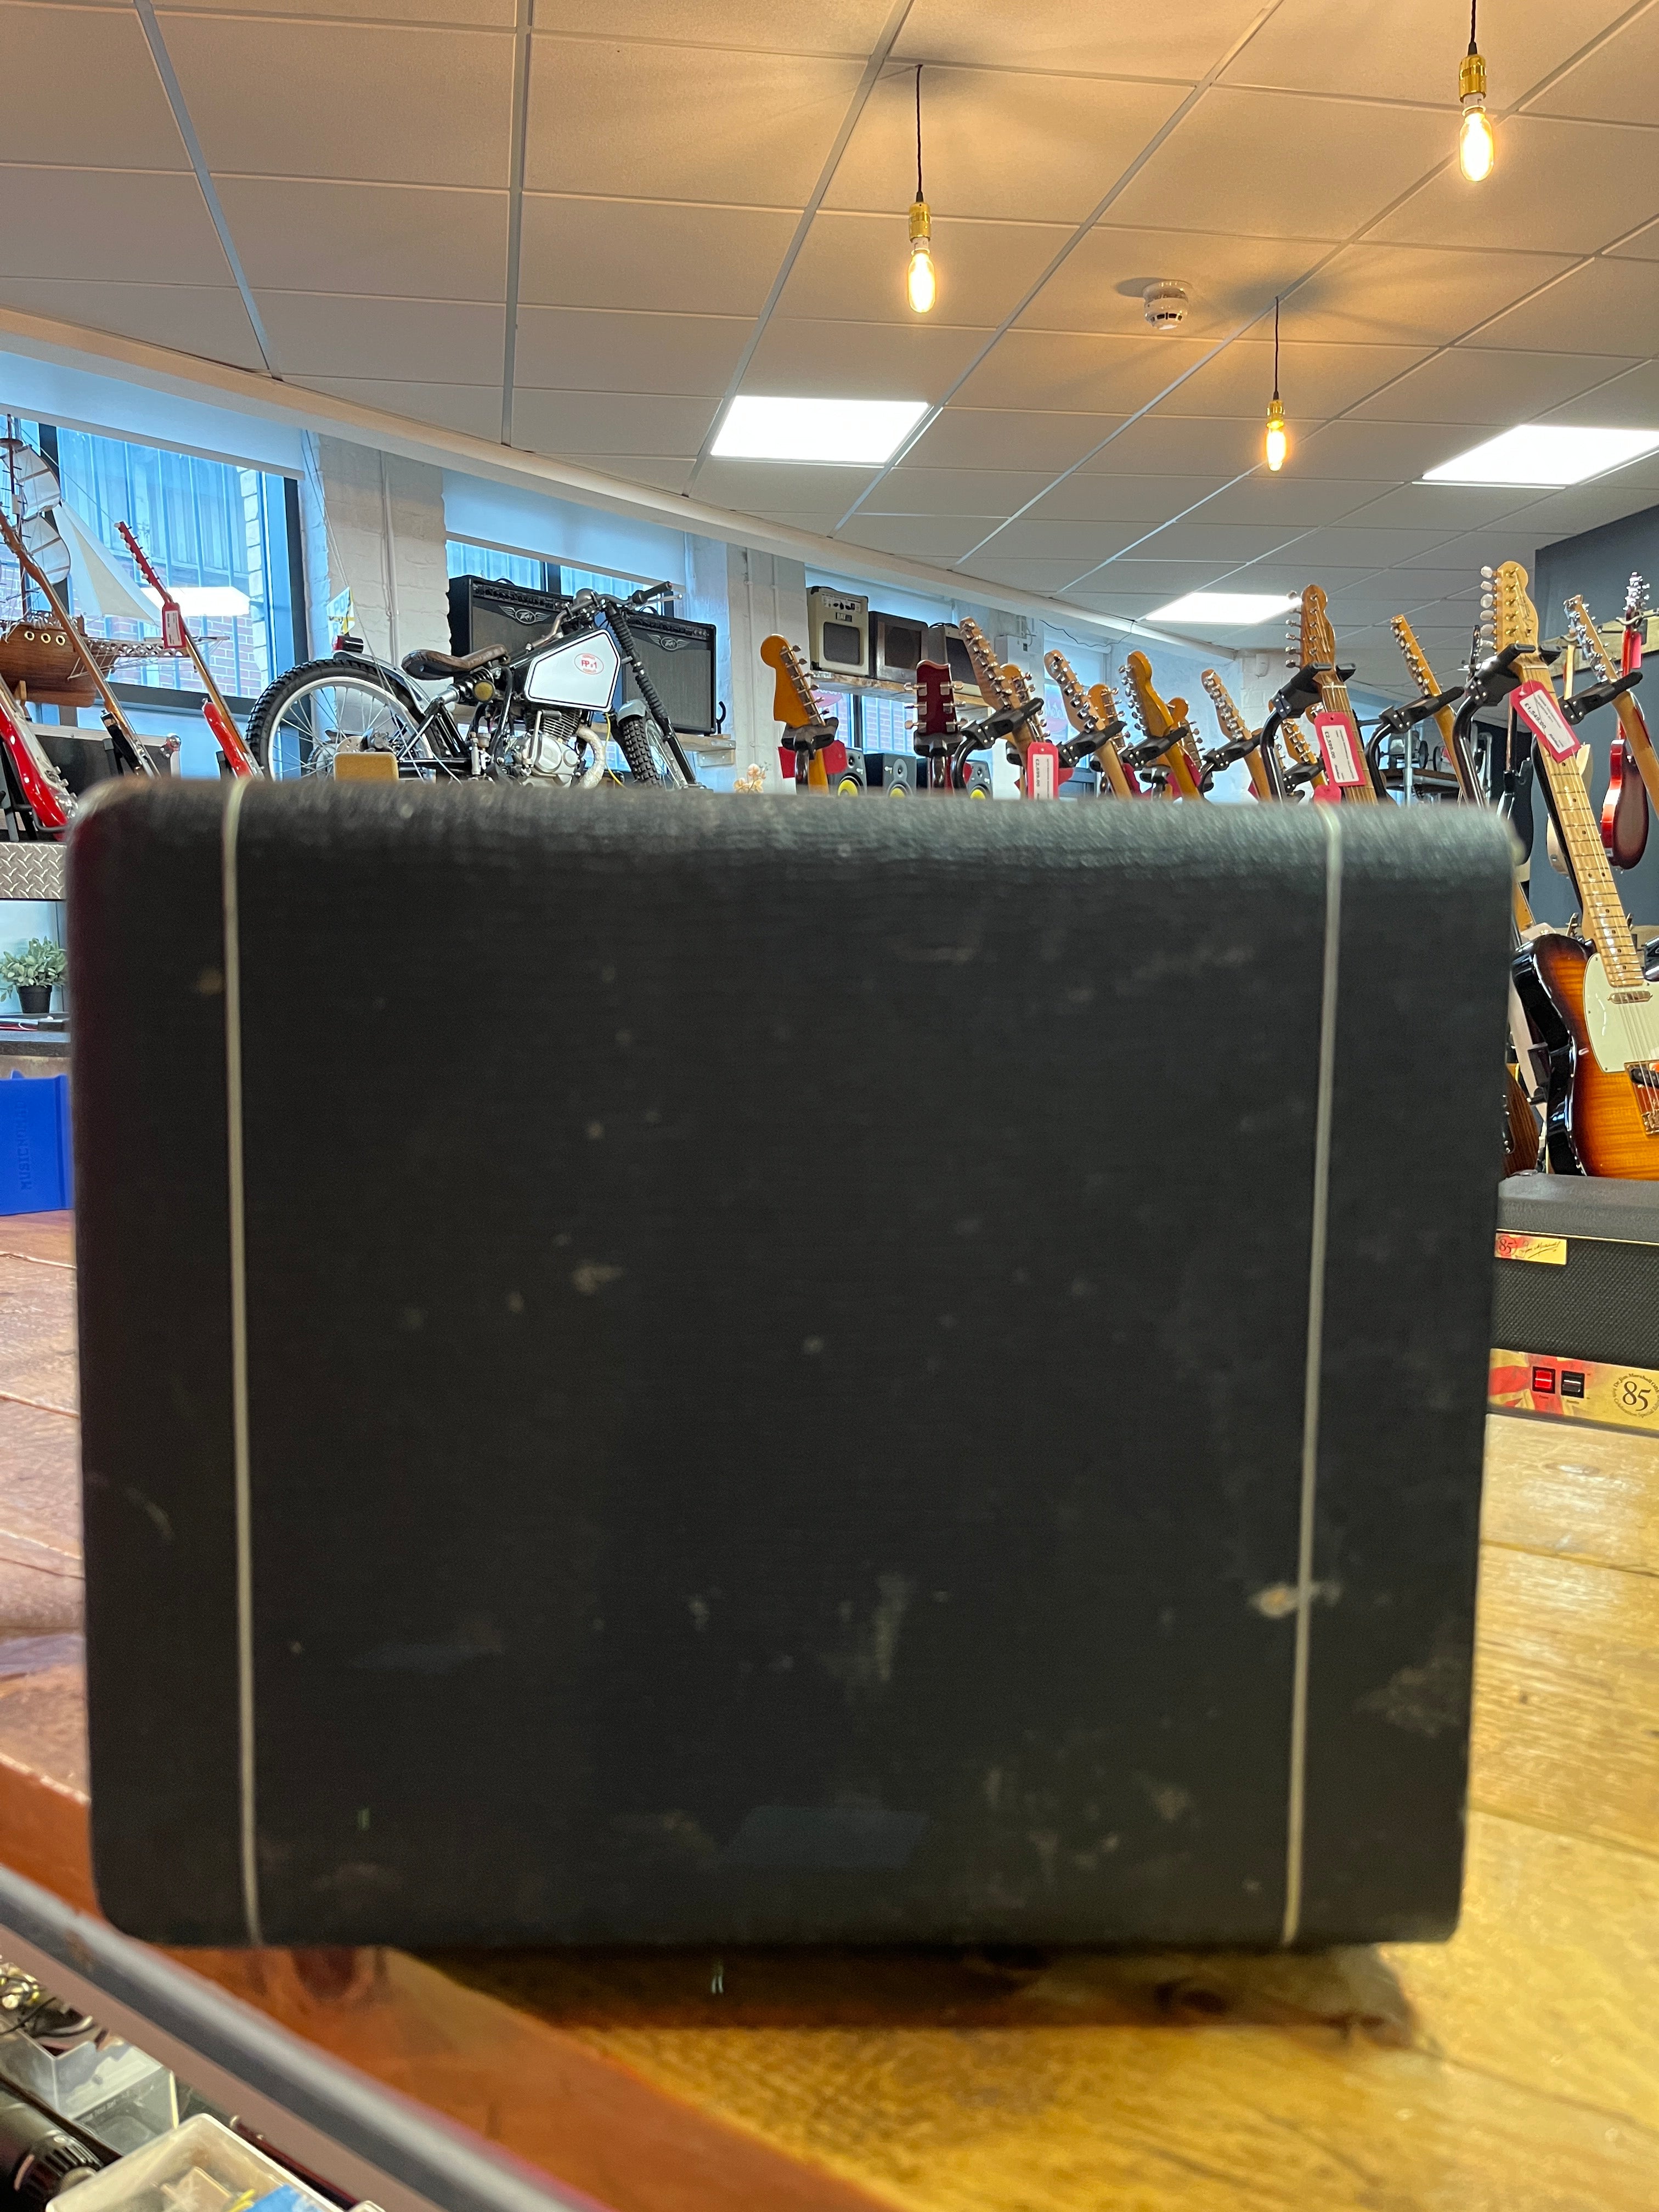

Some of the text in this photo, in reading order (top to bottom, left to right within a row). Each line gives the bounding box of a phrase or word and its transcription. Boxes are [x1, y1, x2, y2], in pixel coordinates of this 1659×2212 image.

[1525, 703, 1547, 729] £1,549.00
[1324, 731, 1336, 759] £2,599.00
[1499, 1239, 1511, 1254] 85
[1622, 1381, 1651, 1412] 85
